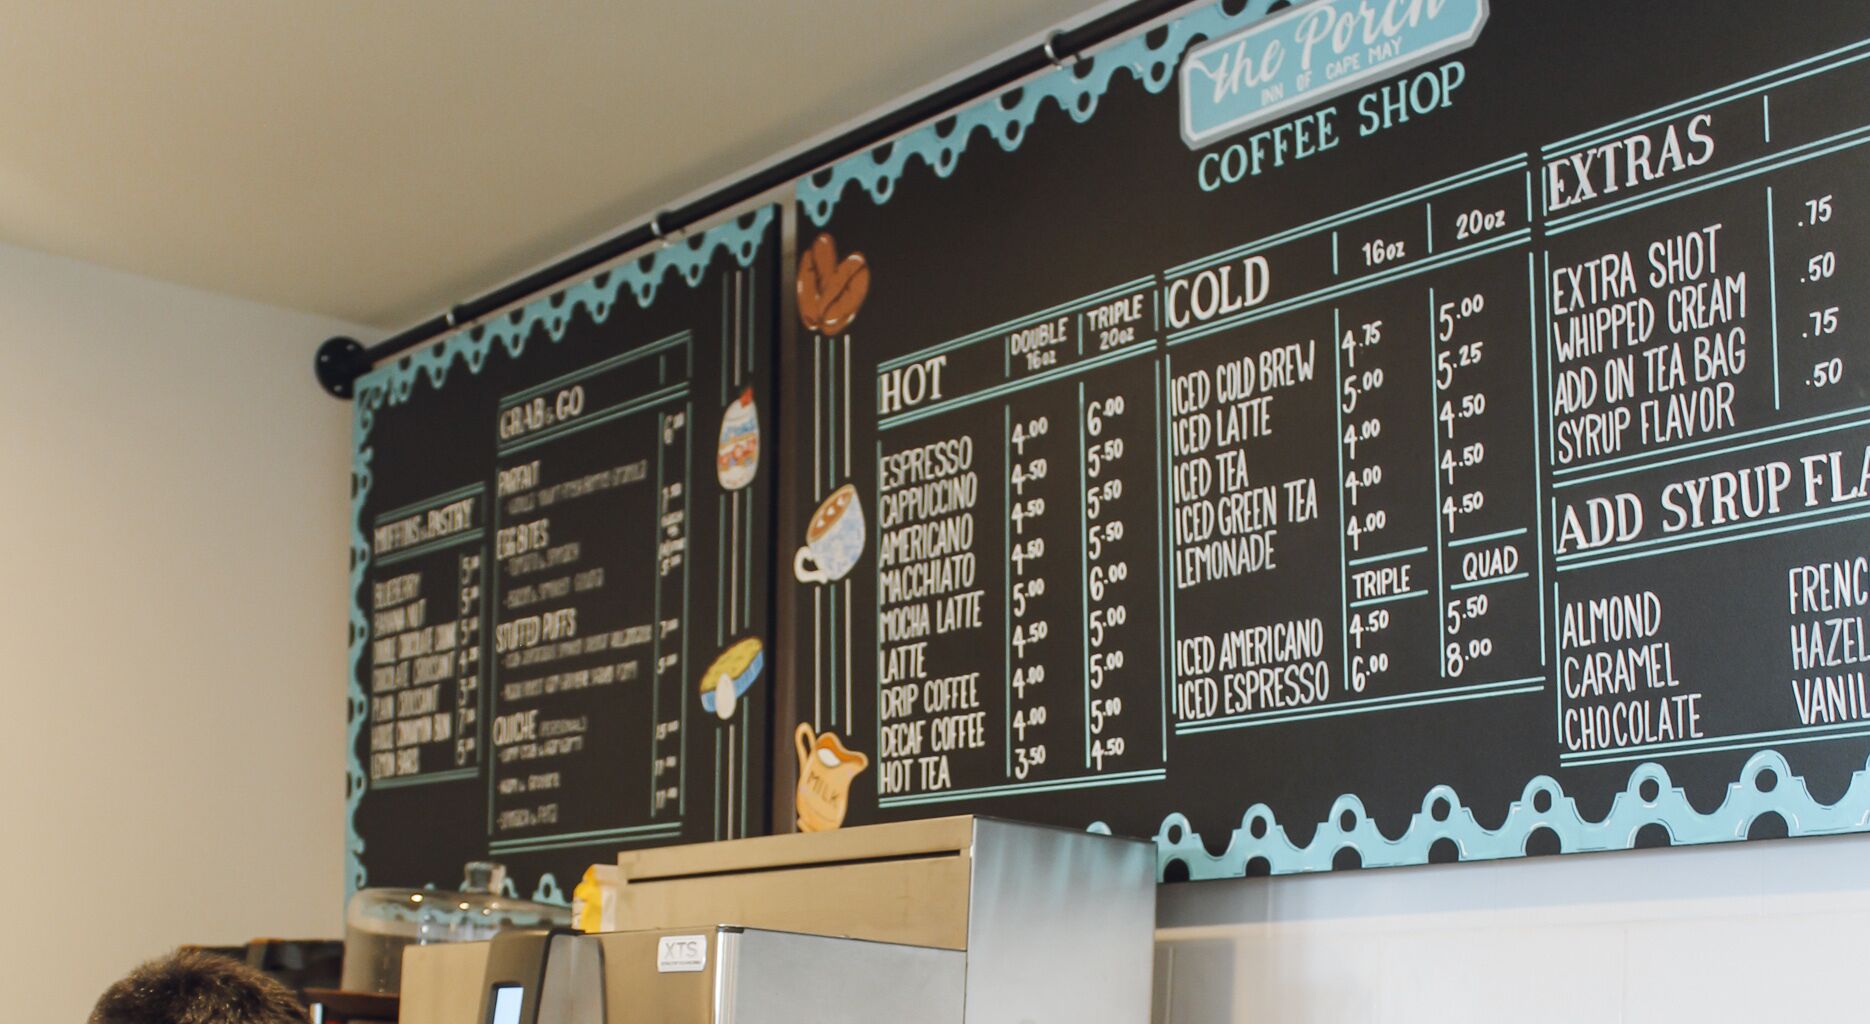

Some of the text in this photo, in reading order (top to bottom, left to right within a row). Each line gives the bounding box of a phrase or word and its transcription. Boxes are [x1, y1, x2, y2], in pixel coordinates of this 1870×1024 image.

[1261, 36, 1404, 107] INN OF CAPE MAY
[1198, 61, 1466, 192] COFFEE SHOP
[1548, 114, 1716, 211] EXTRAS
[1798, 194, 1833, 226] .75
[1553, 223, 1722, 316] EXTRA SHOT
[1800, 251, 1835, 283] .50
[1087, 294, 1144, 331] TRIPLE
[1168, 255, 1271, 330] COLD
[1553, 271, 1746, 363] WHIPPED CREAM
[1011, 317, 1069, 355] DOUBLE
[1438, 293, 1485, 342] 5.00
[1802, 307, 1840, 338] .75
[1341, 320, 1383, 368] 4.75
[1436, 341, 1484, 390] 5.25
[879, 355, 947, 415] HOT
[1171, 338, 1316, 417] ICED COLD BREW
[1342, 368, 1384, 414] 5.00
[1554, 327, 1746, 416] ADD ON TEA BAG
[1805, 357, 1843, 388] .50
[556, 385, 585, 421] GO
[1172, 395, 1275, 457] ICED LATTE
[1439, 393, 1486, 439] 4.50
[1557, 381, 1736, 464] SYRUP FLAVOR
[880, 435, 973, 492] ESPRESSO
[1344, 418, 1381, 460] 4.00
[1441, 442, 1485, 485] 4.50
[880, 471, 978, 528] CAPPUCCINO
[1173, 448, 1249, 504] ICED TEA
[1345, 465, 1382, 506] 4.00
[1175, 478, 1318, 546] ICED GREEN TEA
[1346, 510, 1386, 551] 4.00
[1442, 490, 1484, 533] 4.50
[1556, 493, 1644, 554] ADD
[1661, 461, 1792, 532] SYRUP
[880, 513, 974, 568] AMERICANO
[1176, 530, 1278, 589] LEMONADE
[1462, 545, 1519, 581] QUAD
[880, 552, 976, 606] MACCHIATO
[1352, 564, 1412, 599] TRIPLE
[880, 590, 985, 644] MOCHA LATTE
[1349, 609, 1390, 649] 4.50
[1447, 594, 1489, 635] 5.50
[1562, 591, 1662, 650] ALMOND
[880, 642, 928, 685] LATTE
[1176, 618, 1324, 677] ICED AMERICANO
[1446, 638, 1493, 678] 8.00
[1564, 642, 1680, 699] CARAMEL
[881, 672, 980, 721] DRIP COFFEE
[1178, 660, 1330, 721] ICED ESPRESSO
[1352, 653, 1389, 692] 6.00
[881, 711, 986, 758] DECAF COFFEE
[1565, 693, 1704, 751] CHOCOLATE
[880, 754, 951, 794] HOT TEA
